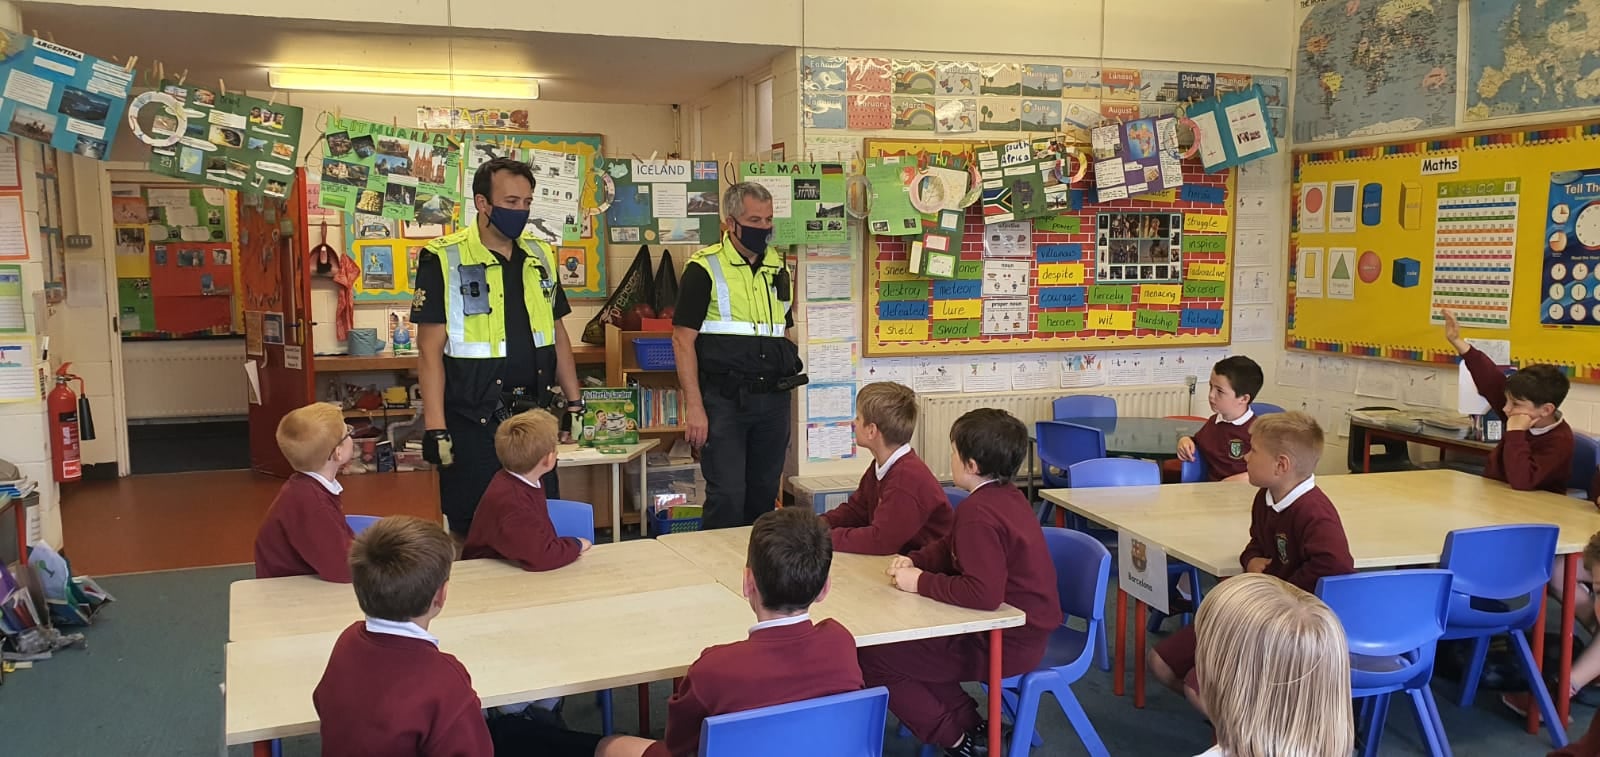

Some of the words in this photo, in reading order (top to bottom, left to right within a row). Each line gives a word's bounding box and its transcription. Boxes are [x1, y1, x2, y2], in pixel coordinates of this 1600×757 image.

[36, 41, 82, 59] ARGENTINA
[459, 108, 490, 126] Art
[1108, 107, 1133, 115] August
[636, 164, 685, 176] ICELAND
[1422, 158, 1458, 172] Maths
[1564, 184, 1583, 194] Tell
[1586, 182, 1600, 193] Th
[1051, 223, 1074, 231] power
[1187, 216, 1218, 230] struggle
[1188, 239, 1220, 252] inspire
[1042, 268, 1074, 283] despite
[882, 283, 921, 298] destroy
[940, 282, 976, 295] meteor
[1143, 289, 1176, 302] menacing
[1041, 293, 1077, 305] courage
[882, 303, 925, 317] defeated
[942, 301, 965, 316] lure
[1046, 315, 1076, 327] heroes
[1098, 312, 1113, 326] wit
[1138, 310, 1174, 328] hardship
[936, 321, 969, 335] sword
